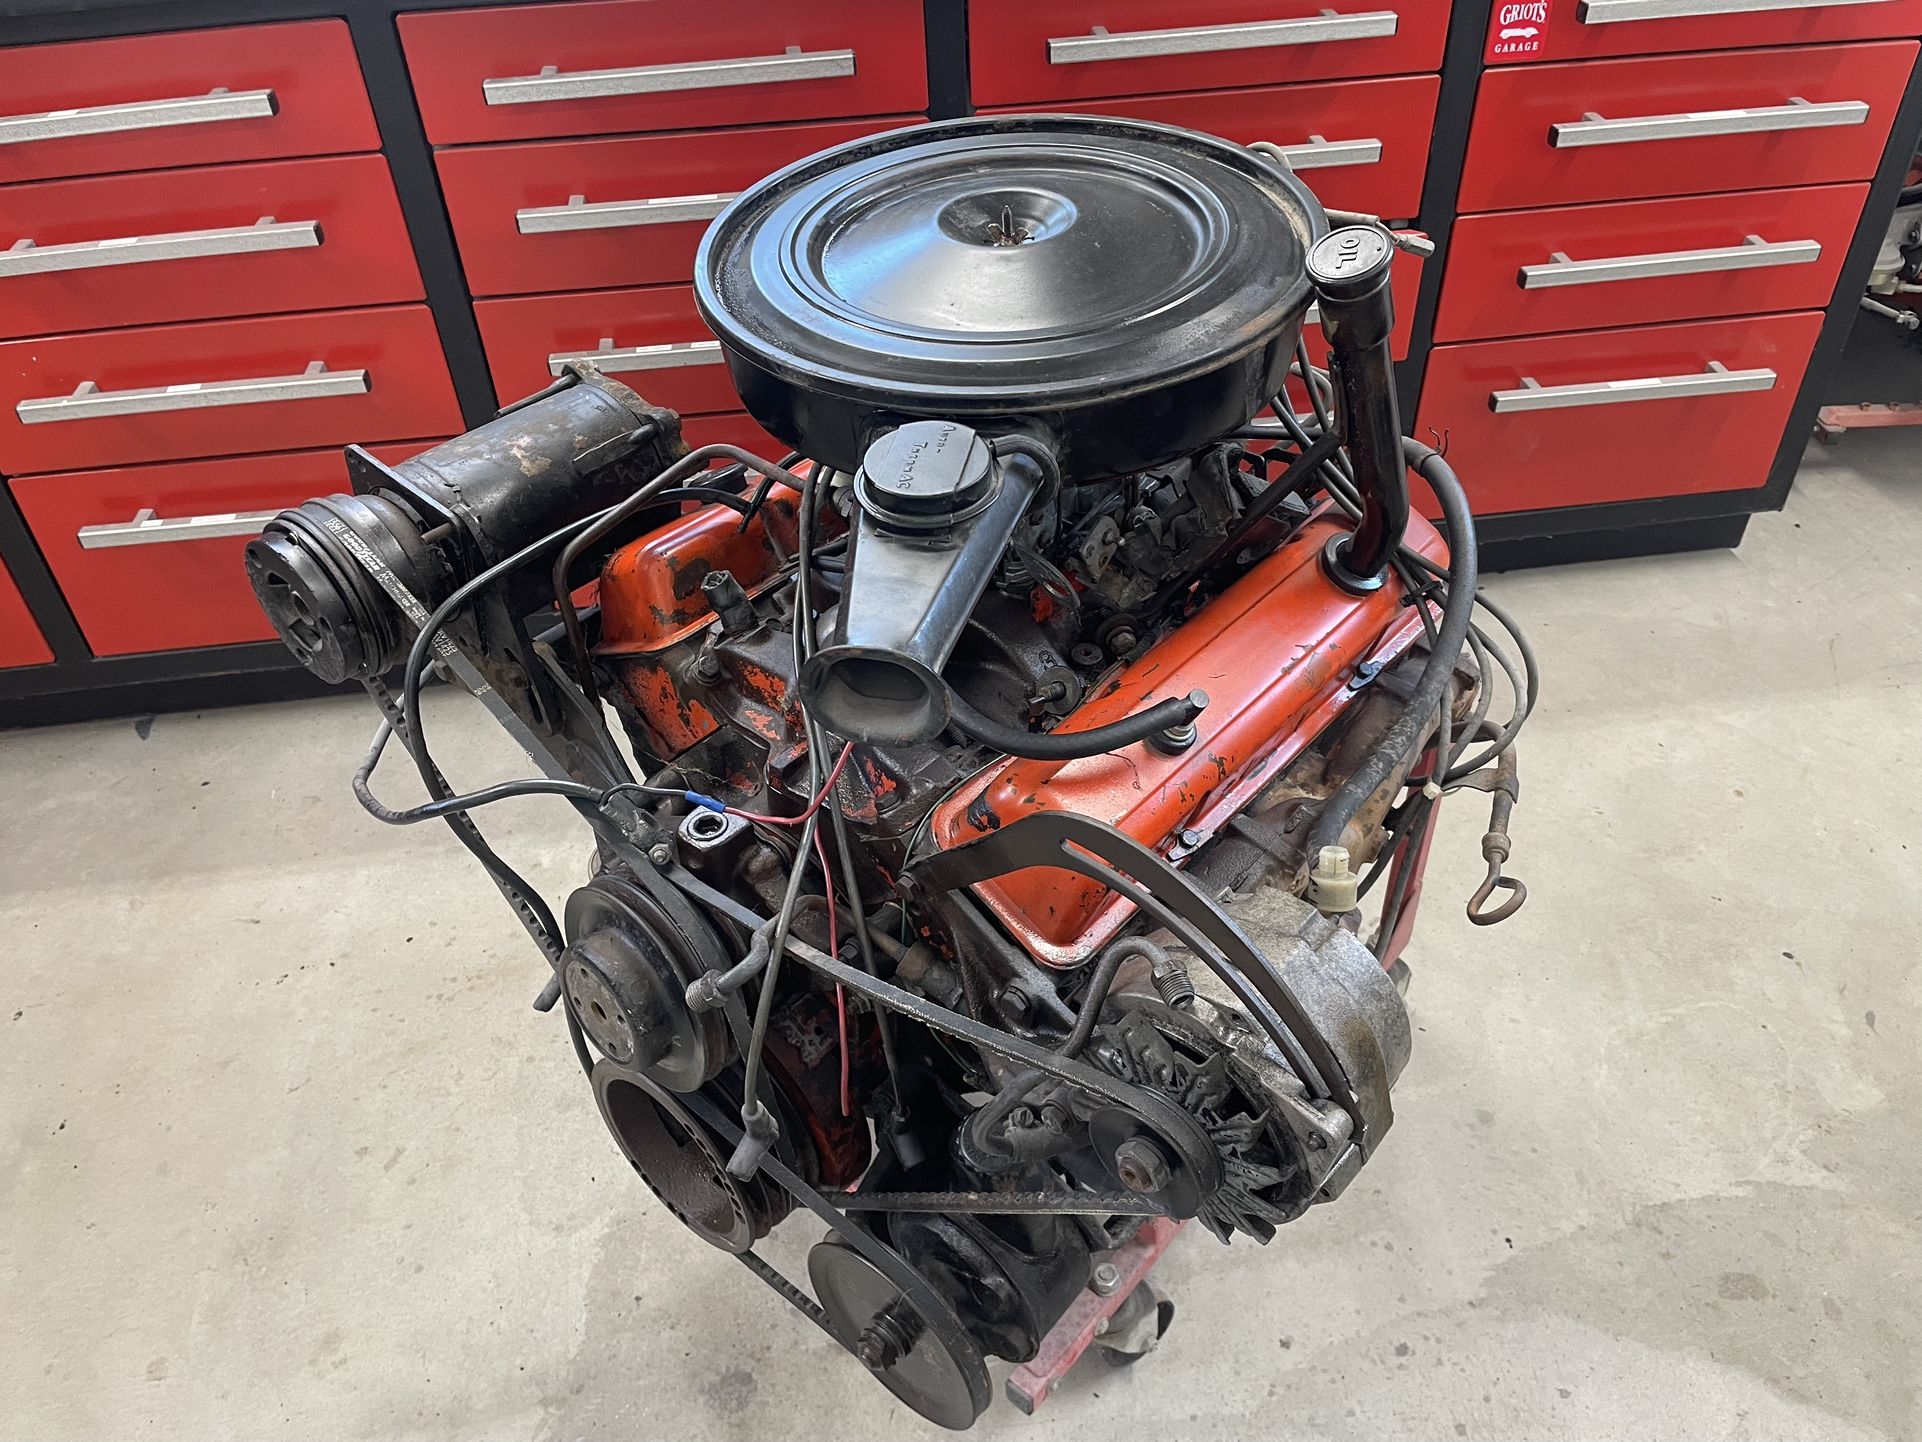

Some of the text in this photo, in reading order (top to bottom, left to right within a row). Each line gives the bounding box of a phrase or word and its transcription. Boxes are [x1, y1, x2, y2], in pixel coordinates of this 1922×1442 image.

[1499, 0, 1548, 25] GRIOT'S
[1494, 41, 1539, 54] GARAGE
[1334, 237, 1361, 269] OIL
[342, 532, 381, 571] GOODYEAR
